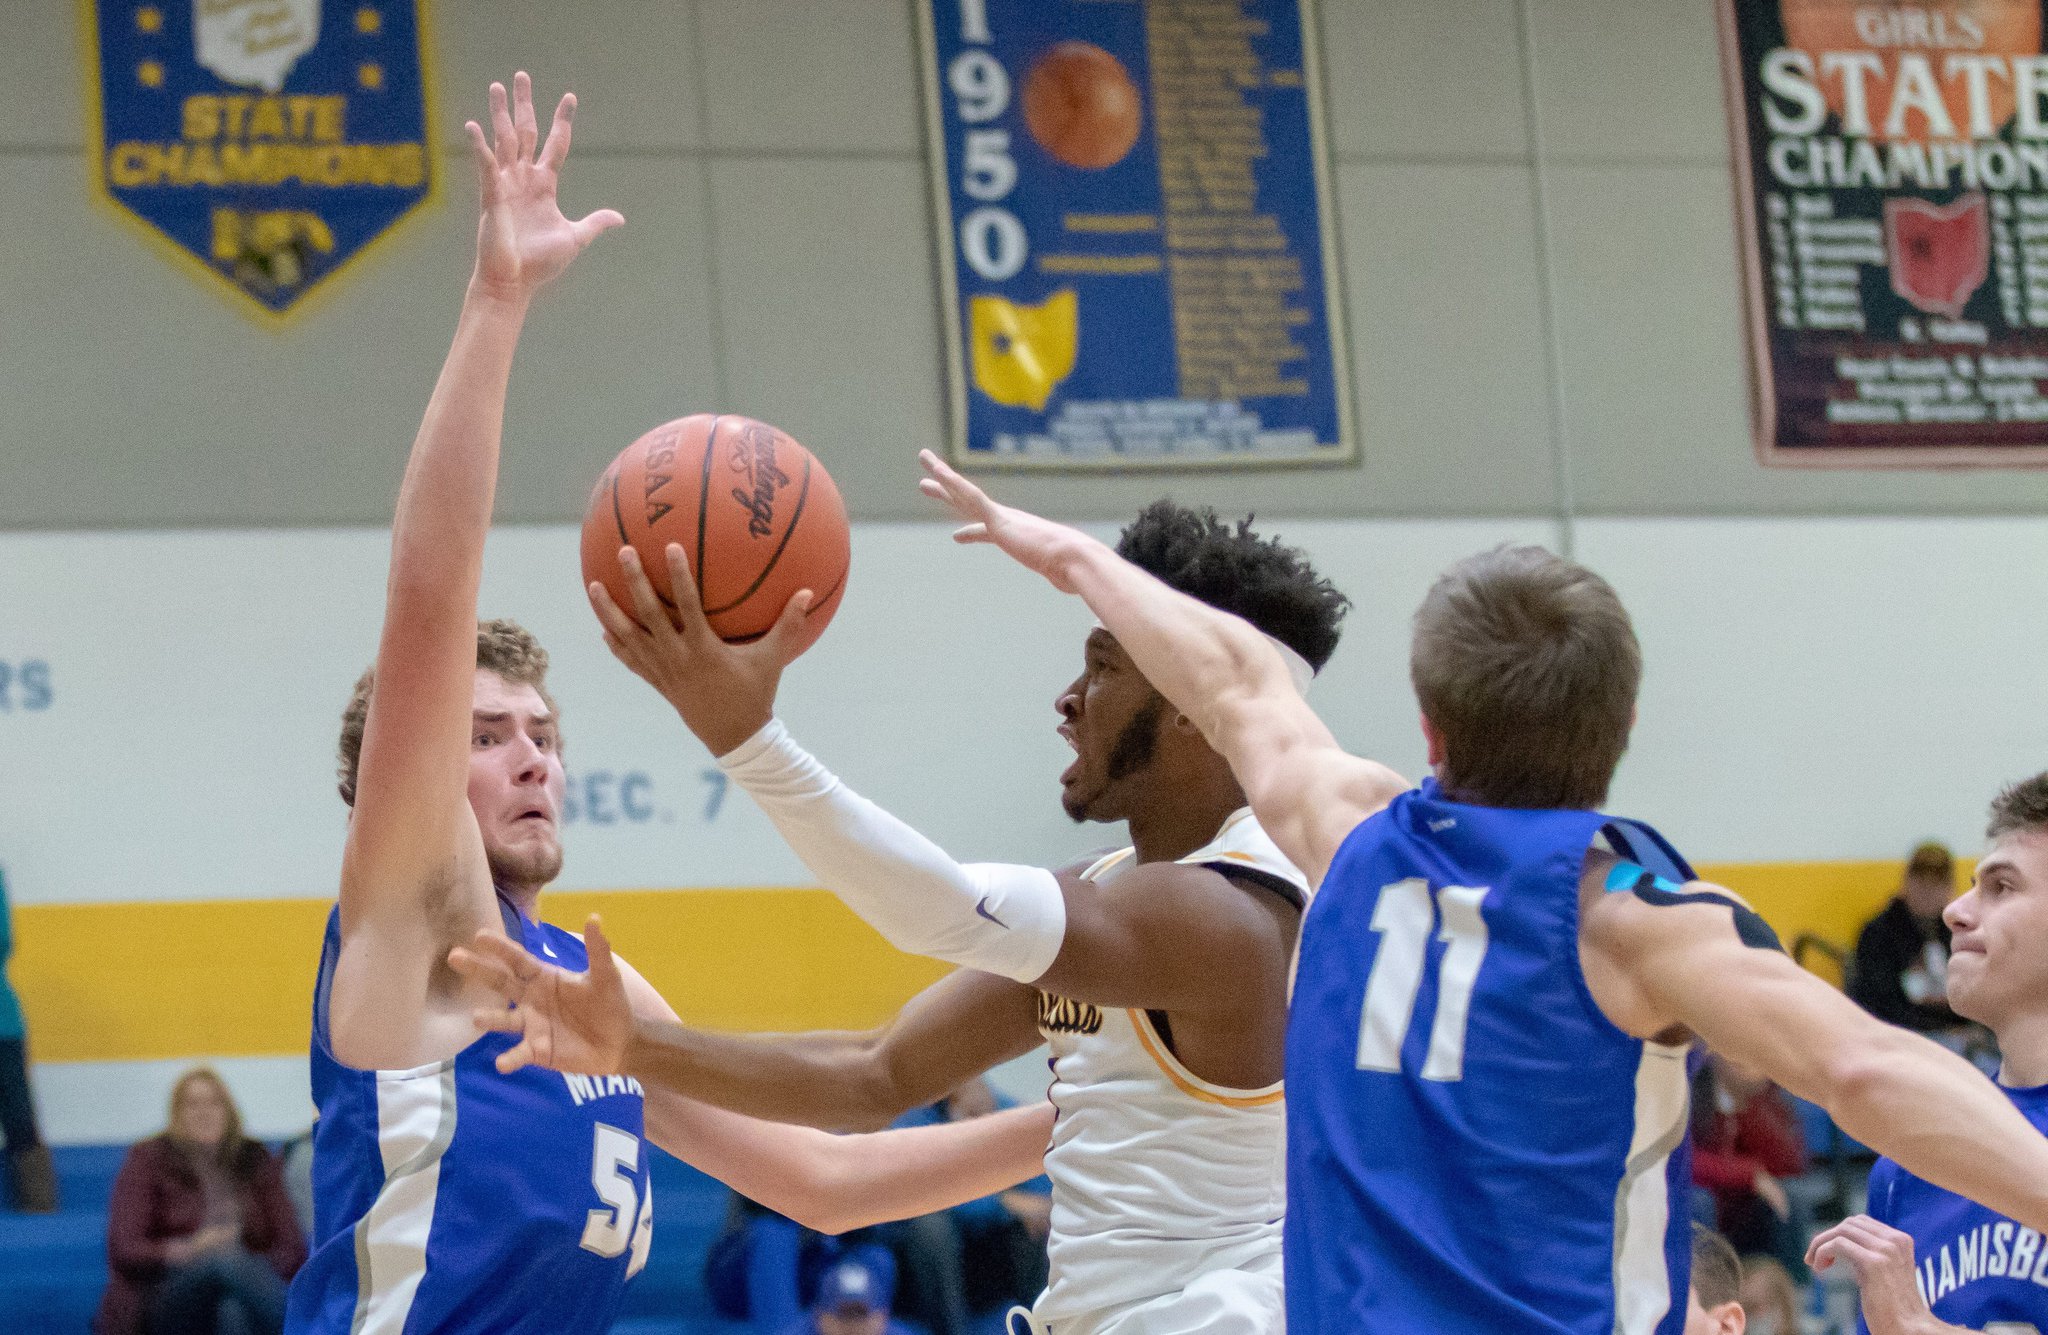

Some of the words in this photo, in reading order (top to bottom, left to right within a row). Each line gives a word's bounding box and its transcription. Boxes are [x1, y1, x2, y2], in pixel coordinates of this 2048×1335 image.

[1855, 7, 1984, 48] GIRLS
[182, 95, 346, 140] STATE
[1760, 48, 2048, 138] STATE
[110, 142, 426, 187] CHAMPIONS
[702, 769, 727, 822] 7
[1355, 877, 1489, 1082] 11
